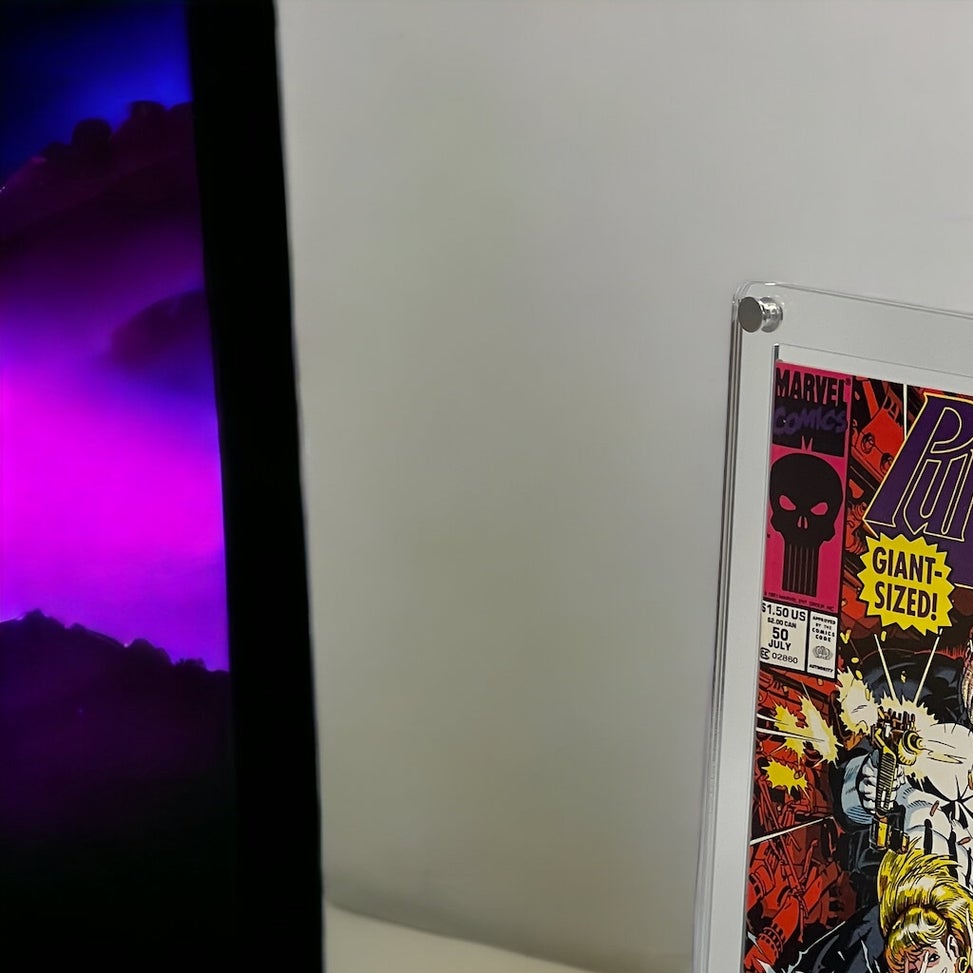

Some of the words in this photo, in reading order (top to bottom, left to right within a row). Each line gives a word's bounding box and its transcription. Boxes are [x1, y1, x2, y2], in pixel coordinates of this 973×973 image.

[775, 367, 847, 408] MARVEL
[774, 406, 847, 434] COMICS
[872, 550, 942, 584] GIANT-
[874, 581, 937, 621] SIZED!
[761, 603, 789, 618] $1.50
[791, 609, 806, 621] US
[772, 627, 789, 641] 50
[811, 628, 835, 638] COMICS
[815, 634, 832, 643] CODE
[768, 640, 791, 651] JULY
[772, 652, 798, 664] 02860
